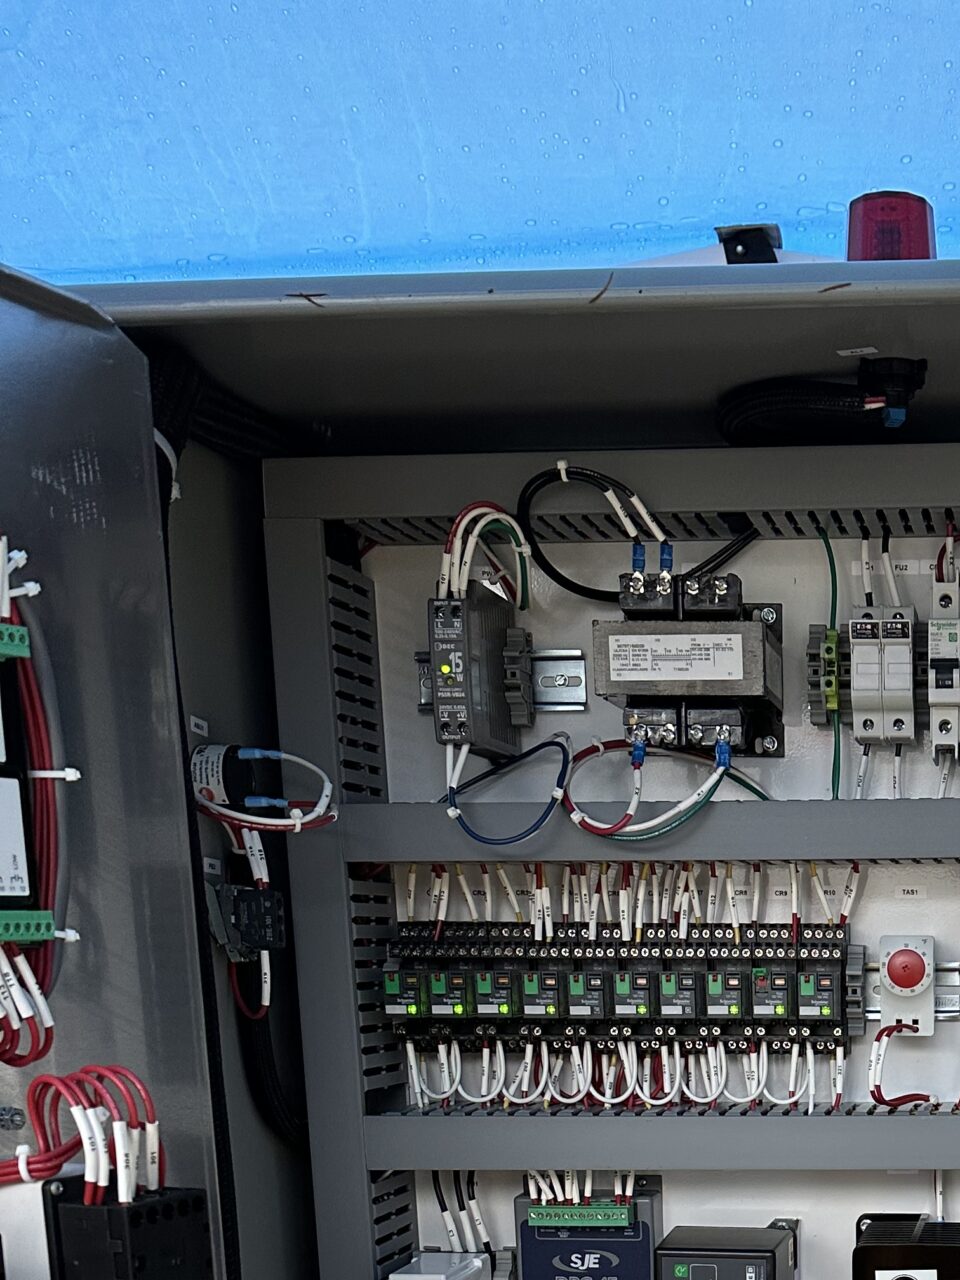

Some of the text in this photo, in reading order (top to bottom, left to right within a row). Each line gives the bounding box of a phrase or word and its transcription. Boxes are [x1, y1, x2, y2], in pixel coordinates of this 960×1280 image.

[930, 621, 958, 630] Schneider
[449, 652, 464, 673] 15
[570, 1253, 600, 1270] SJE
